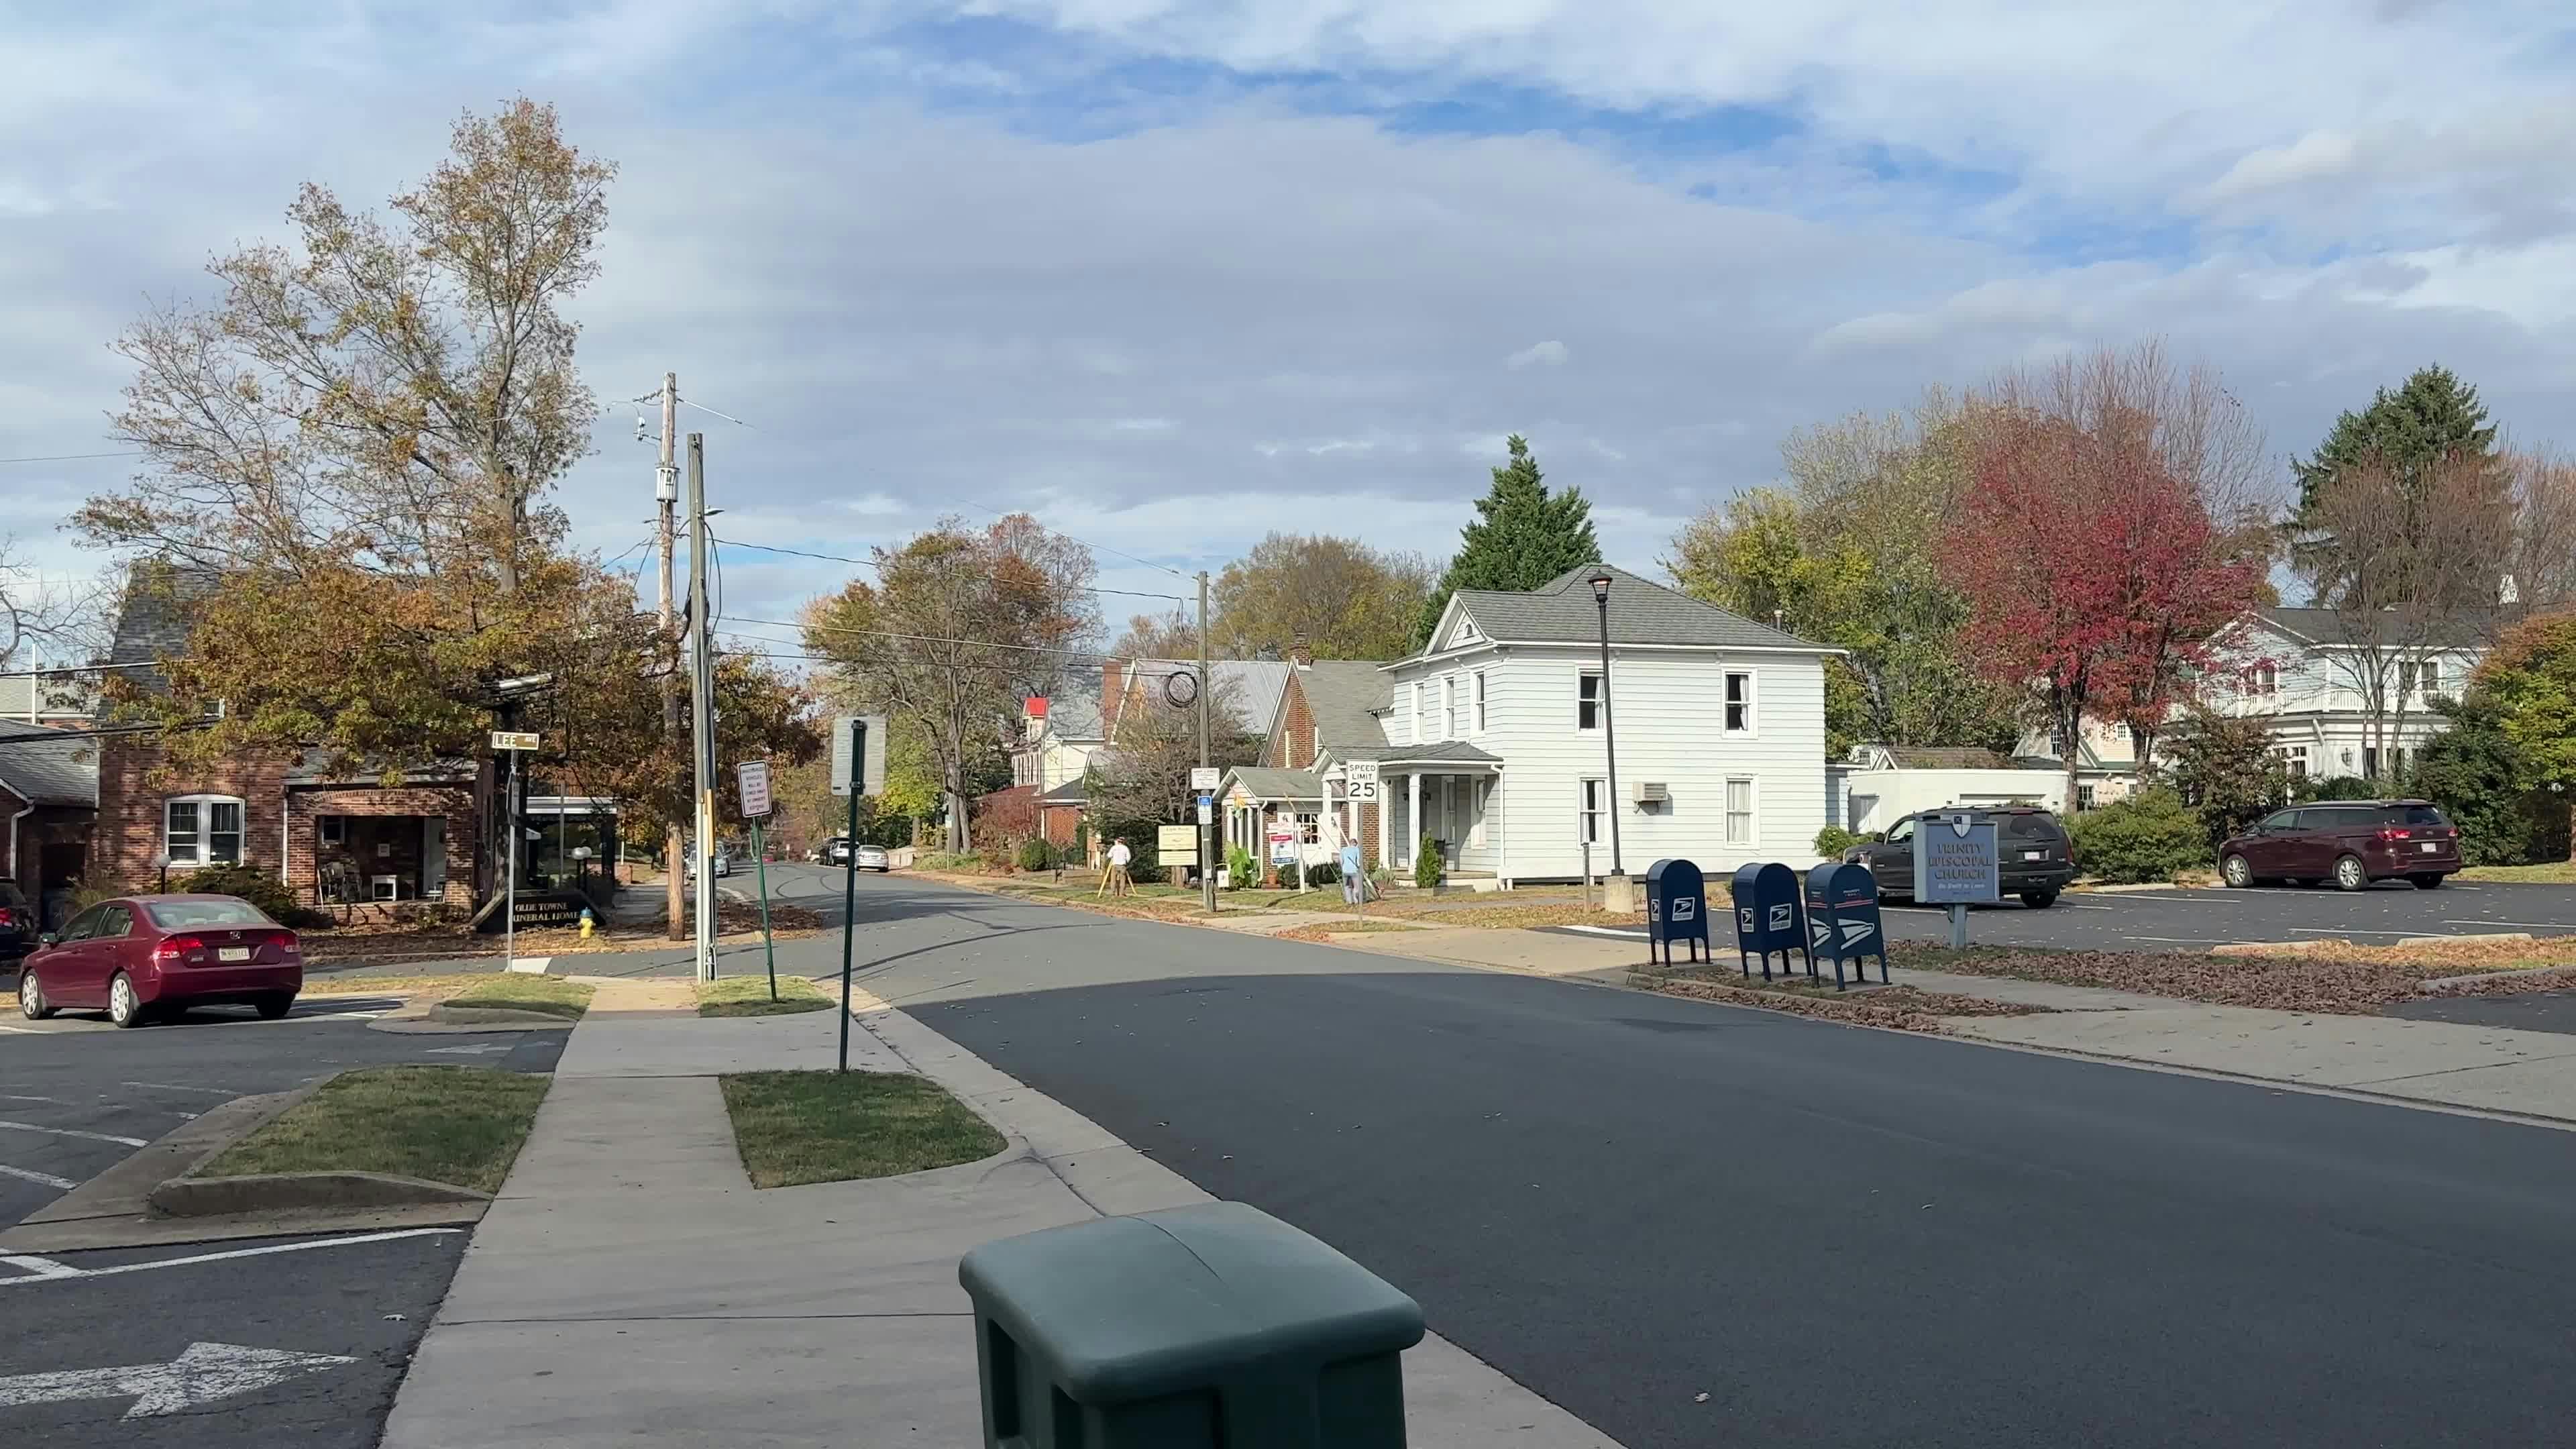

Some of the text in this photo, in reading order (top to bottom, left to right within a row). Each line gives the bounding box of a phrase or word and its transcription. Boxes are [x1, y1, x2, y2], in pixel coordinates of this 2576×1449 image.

[495, 735, 516, 746] LEE
[1350, 782, 1375, 797] 25
[1937, 843, 1983, 854] TRINITY
[1928, 856, 1992, 867] EPISCOPAL
[1934, 869, 1986, 879] CHURCH
[515, 902, 568, 912] OLDE TOWNE
[513, 912, 580, 922] UNERAL HOME
